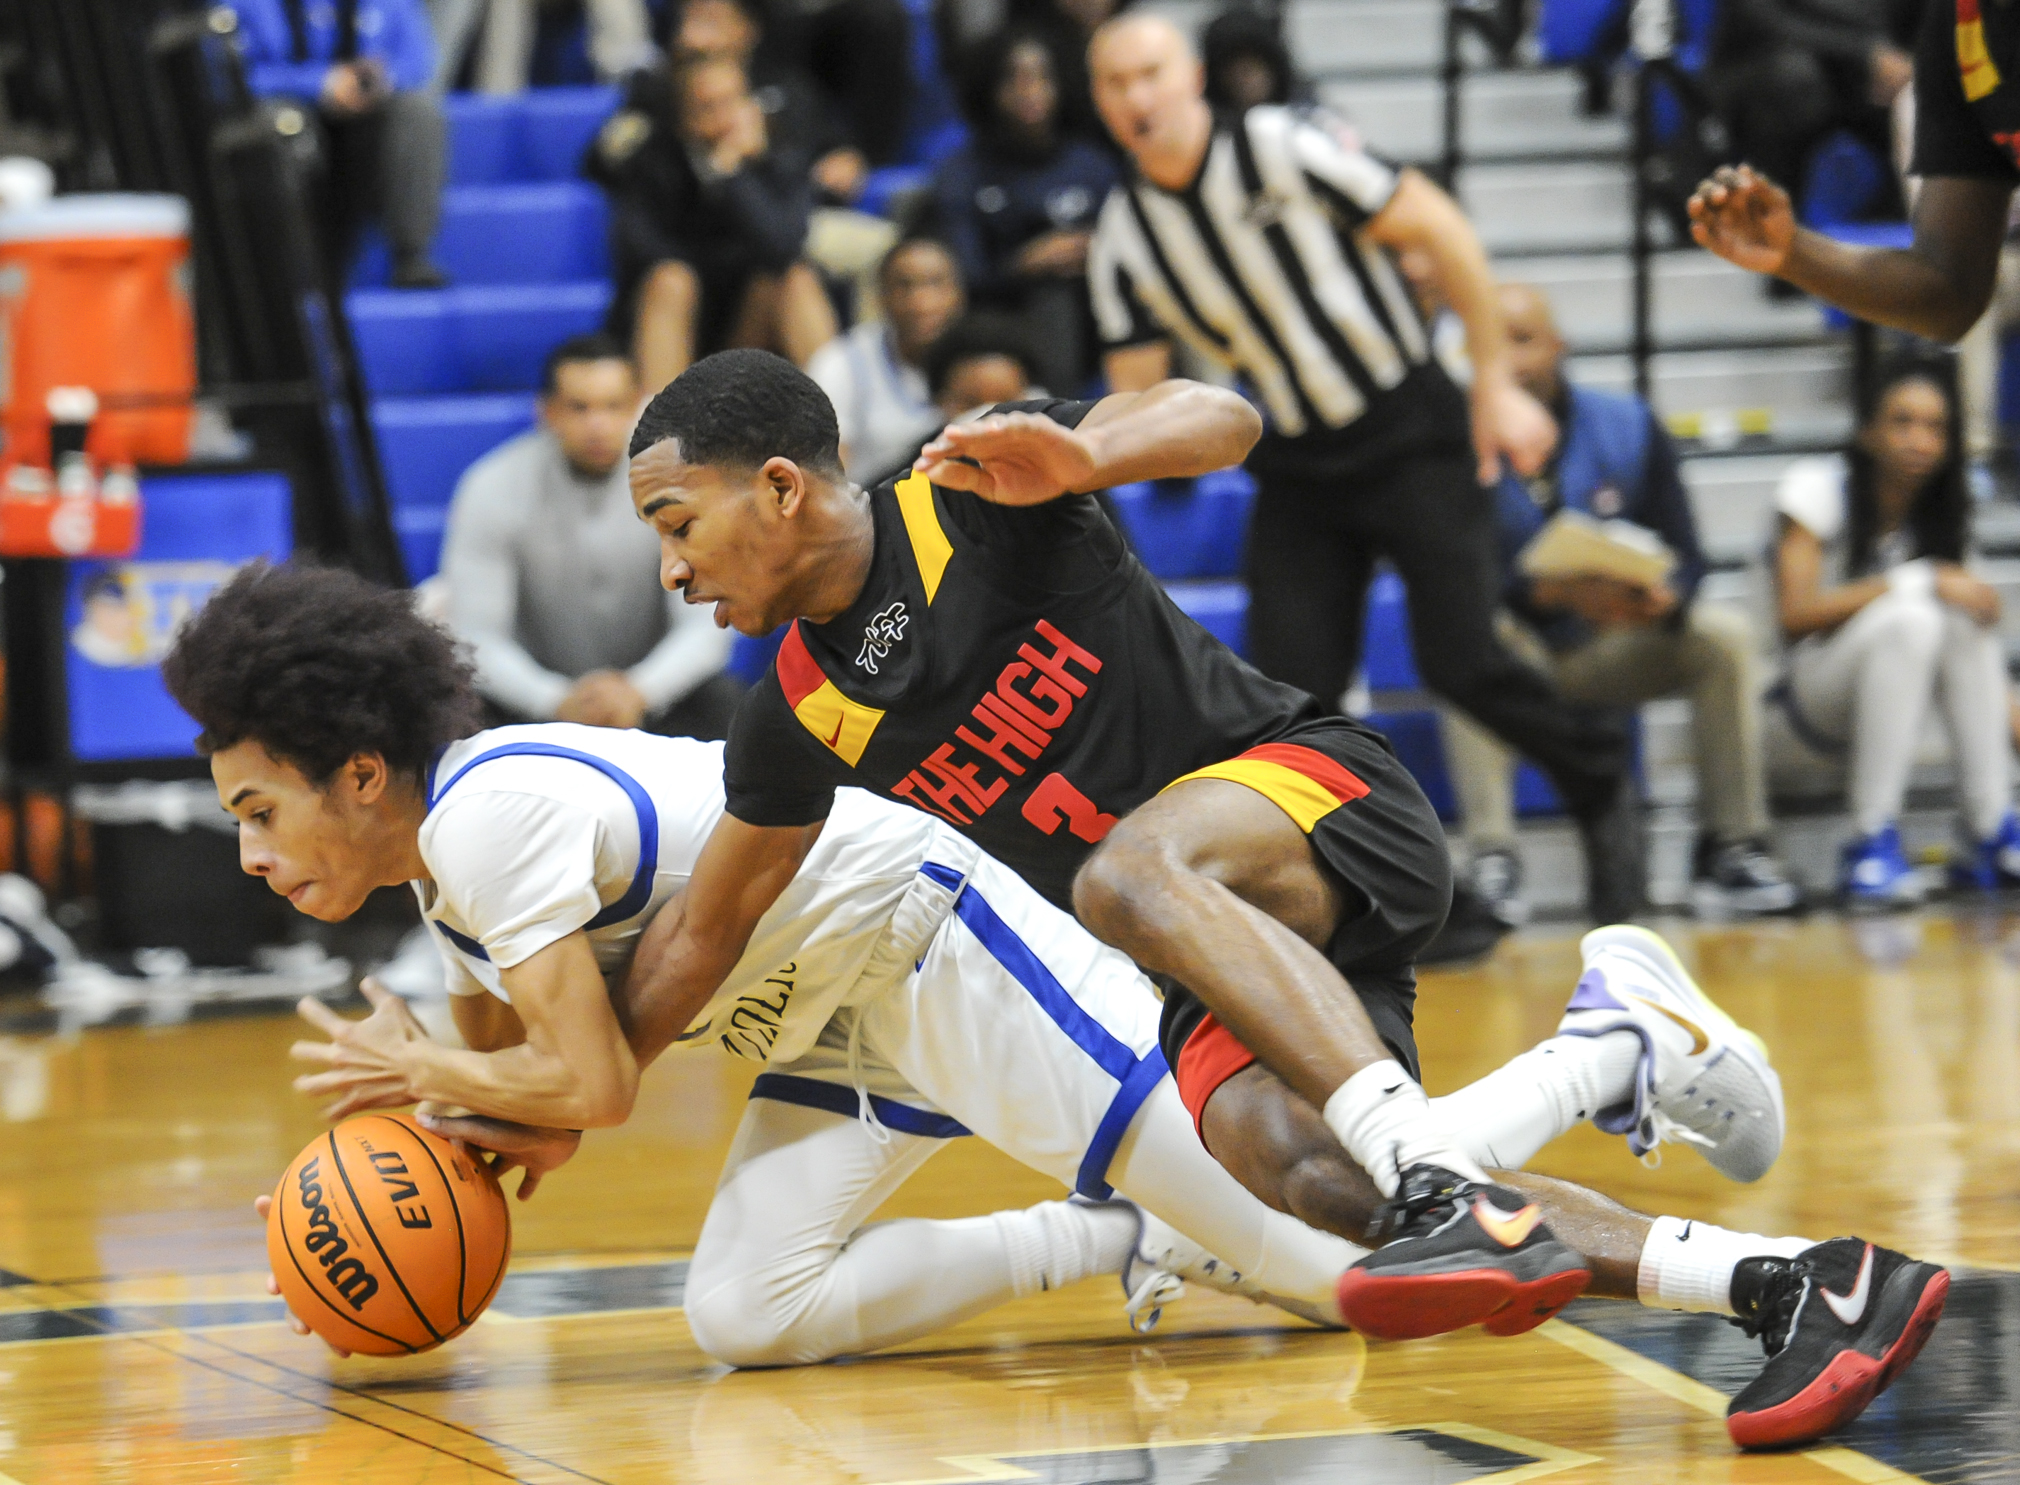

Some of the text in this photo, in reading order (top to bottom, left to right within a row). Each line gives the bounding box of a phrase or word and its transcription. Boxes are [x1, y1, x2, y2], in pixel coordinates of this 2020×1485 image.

[890, 618, 1103, 826] THE HIGH
[298, 1156, 379, 1312] Wilson
[369, 1151, 432, 1229] EVO
